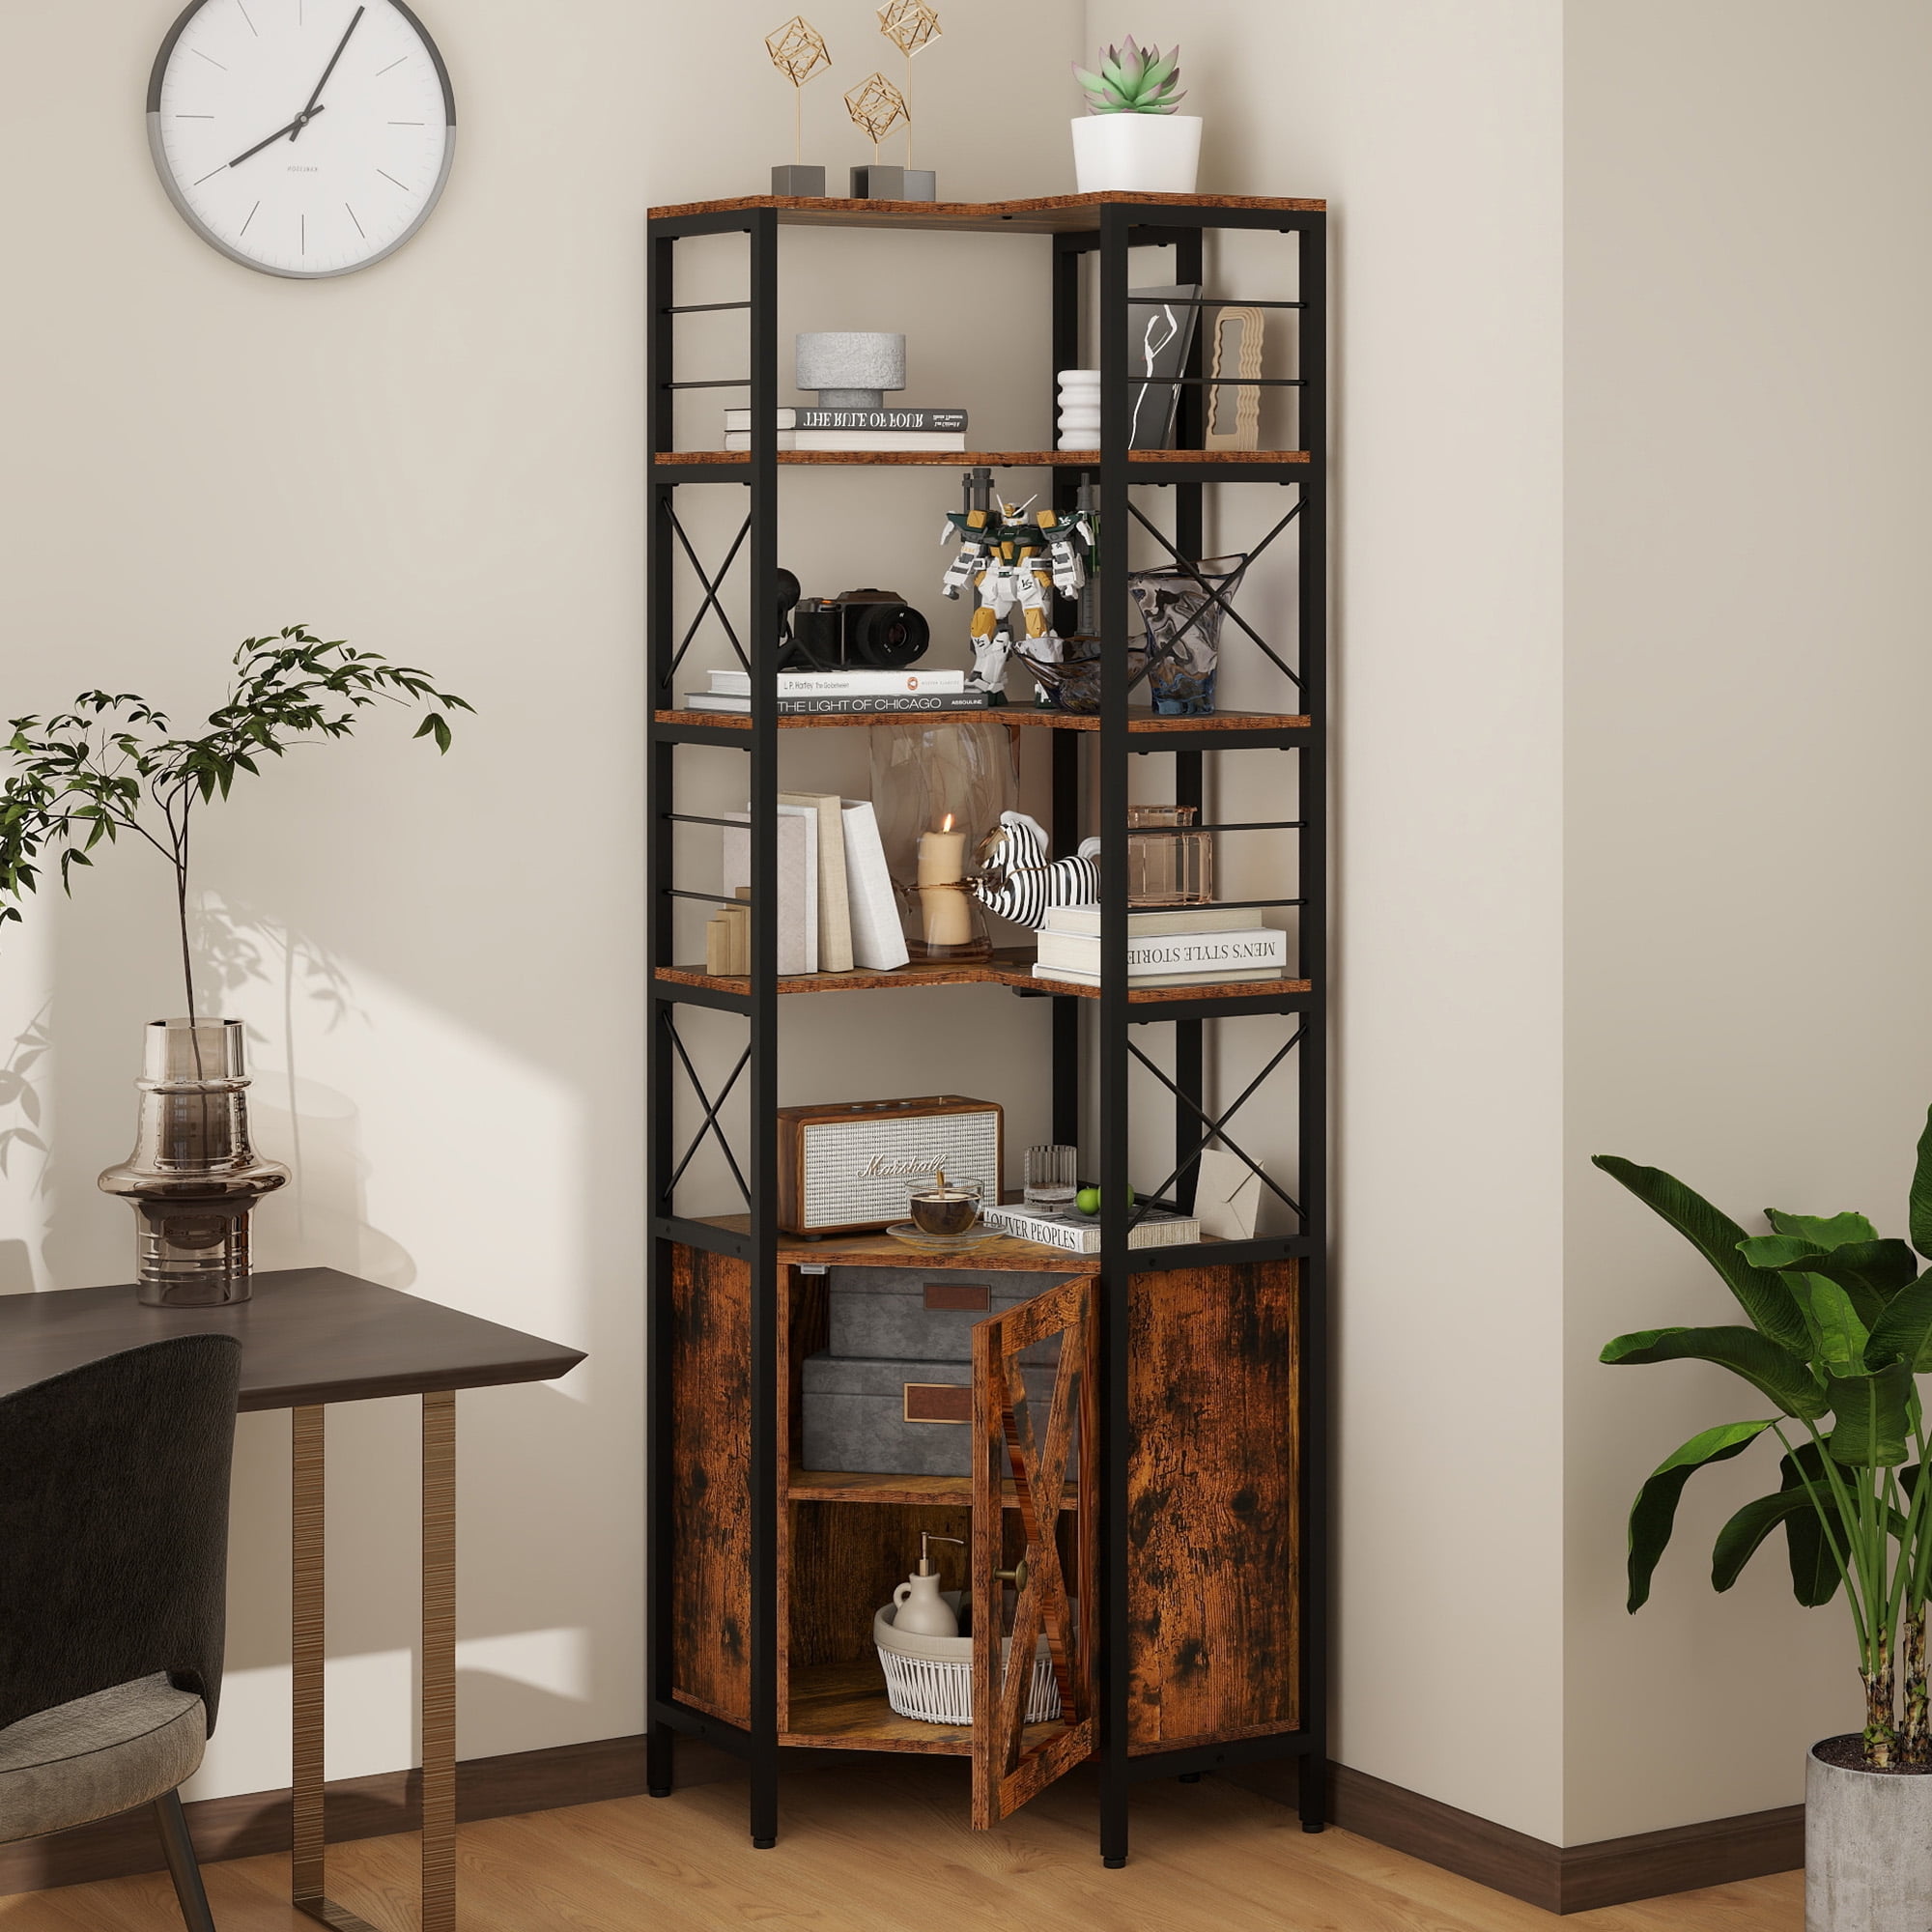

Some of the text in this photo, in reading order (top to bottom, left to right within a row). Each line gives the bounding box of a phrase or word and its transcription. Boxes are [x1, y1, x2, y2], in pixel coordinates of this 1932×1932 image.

[777, 697, 942, 712] THE LIGHT OF CHICAGO
[1127, 941, 1276, 965] MEN'S STYLE STORIE
[857, 1152, 948, 1178] Marshall
[1031, 1222, 1076, 1251] PEOPLES
